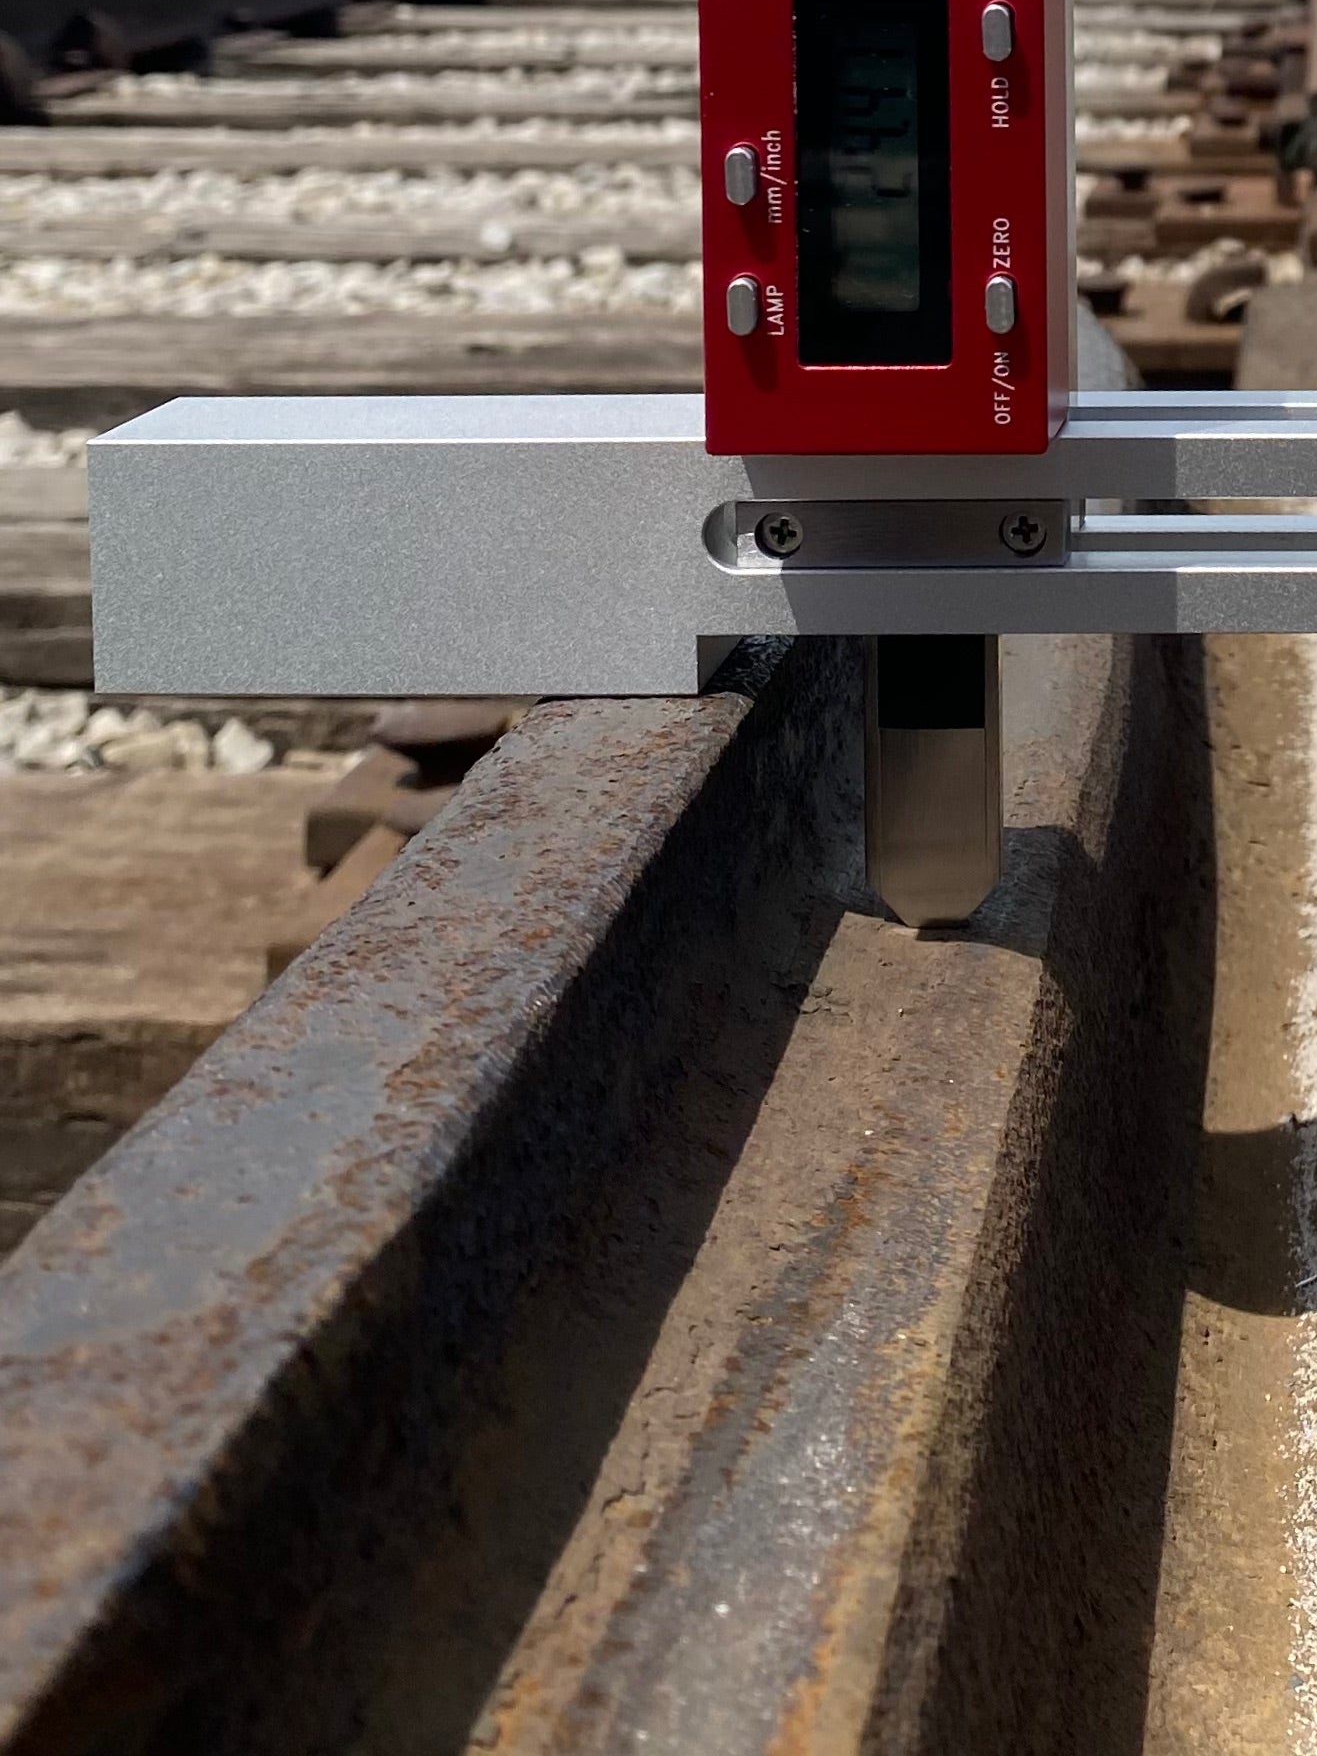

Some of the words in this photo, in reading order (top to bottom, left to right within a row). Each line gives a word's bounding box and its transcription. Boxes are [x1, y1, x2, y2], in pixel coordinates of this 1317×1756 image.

[991, 77, 1010, 128] HOLD
[760, 130, 787, 223] mm/inch
[992, 217, 1011, 269] ZERO
[765, 285, 785, 336] LAMP
[992, 351, 1015, 425] OFF/ON
